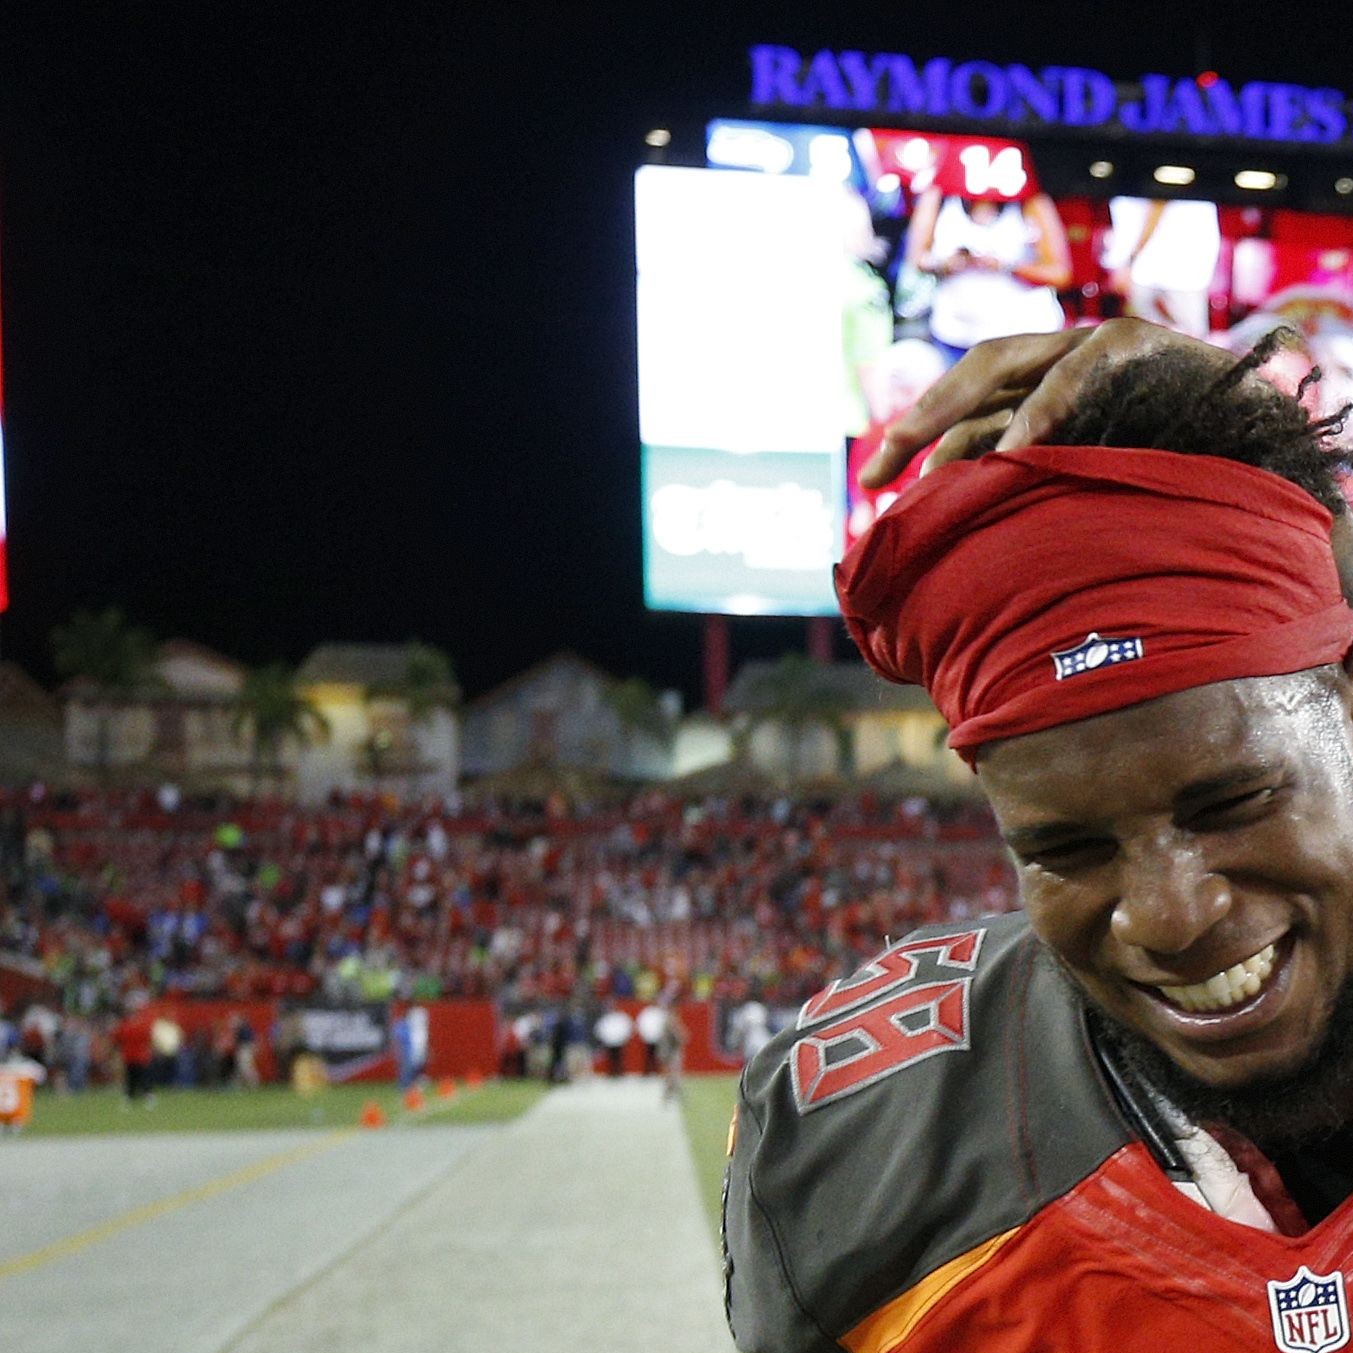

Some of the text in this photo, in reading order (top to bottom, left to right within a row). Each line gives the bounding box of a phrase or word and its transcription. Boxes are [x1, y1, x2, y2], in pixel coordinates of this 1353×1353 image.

[749, 43, 1117, 128] RAYMOND
[1118, 72, 1347, 145] JAMES
[1285, 1308, 1338, 1346] NFL
